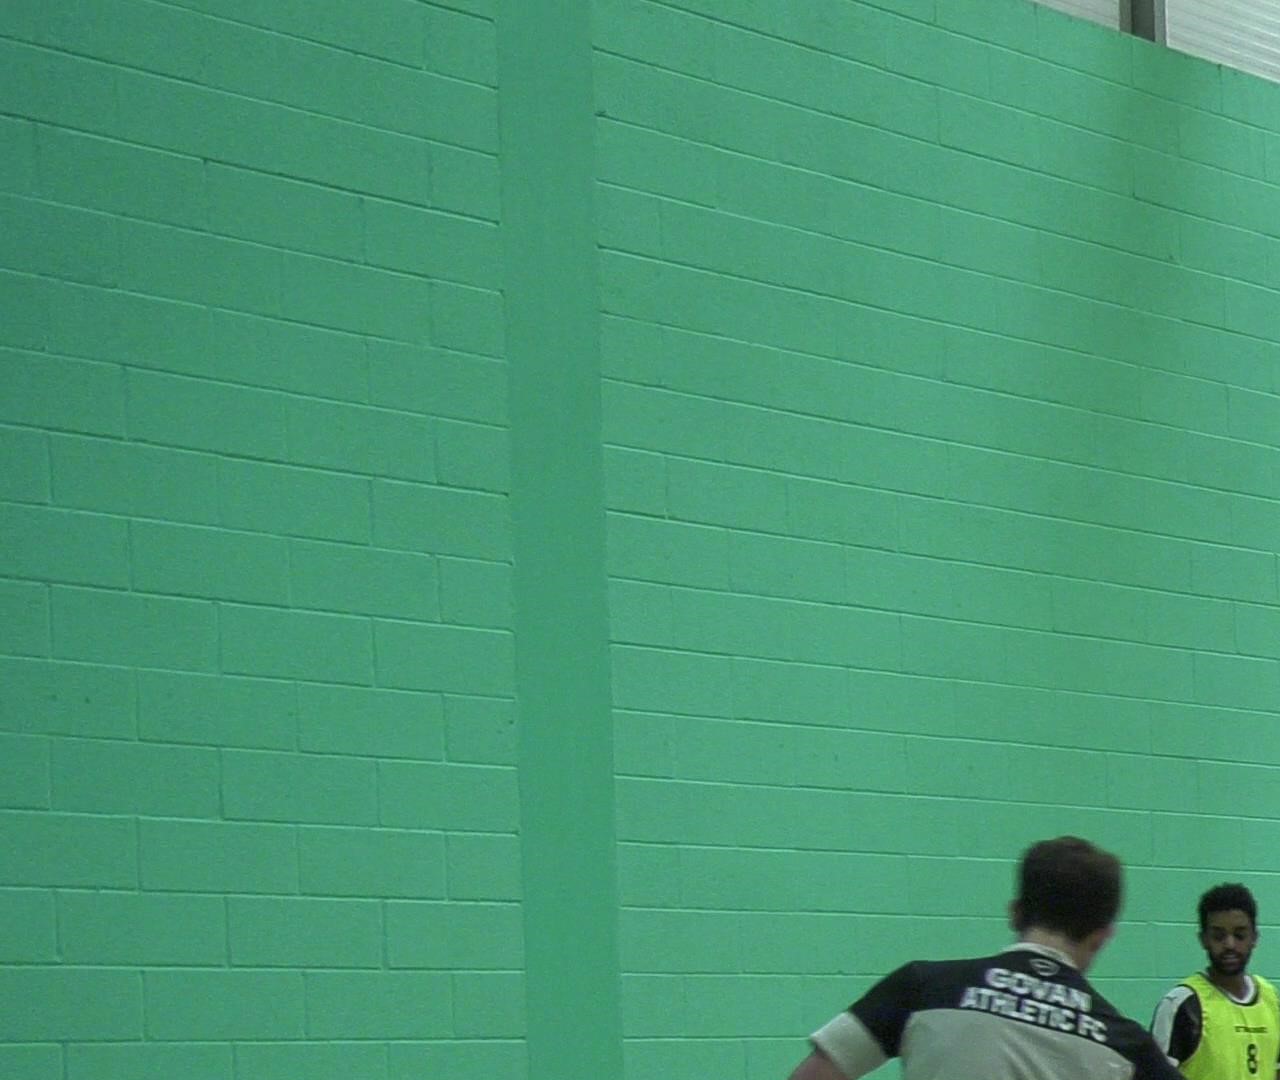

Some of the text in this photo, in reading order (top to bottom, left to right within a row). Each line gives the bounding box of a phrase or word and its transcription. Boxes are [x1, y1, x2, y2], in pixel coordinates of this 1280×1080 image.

[985, 967, 1092, 1012] GOVAN
[960, 986, 1108, 1042] ATHLETIC FC
[1246, 1043, 1258, 1075] 8
